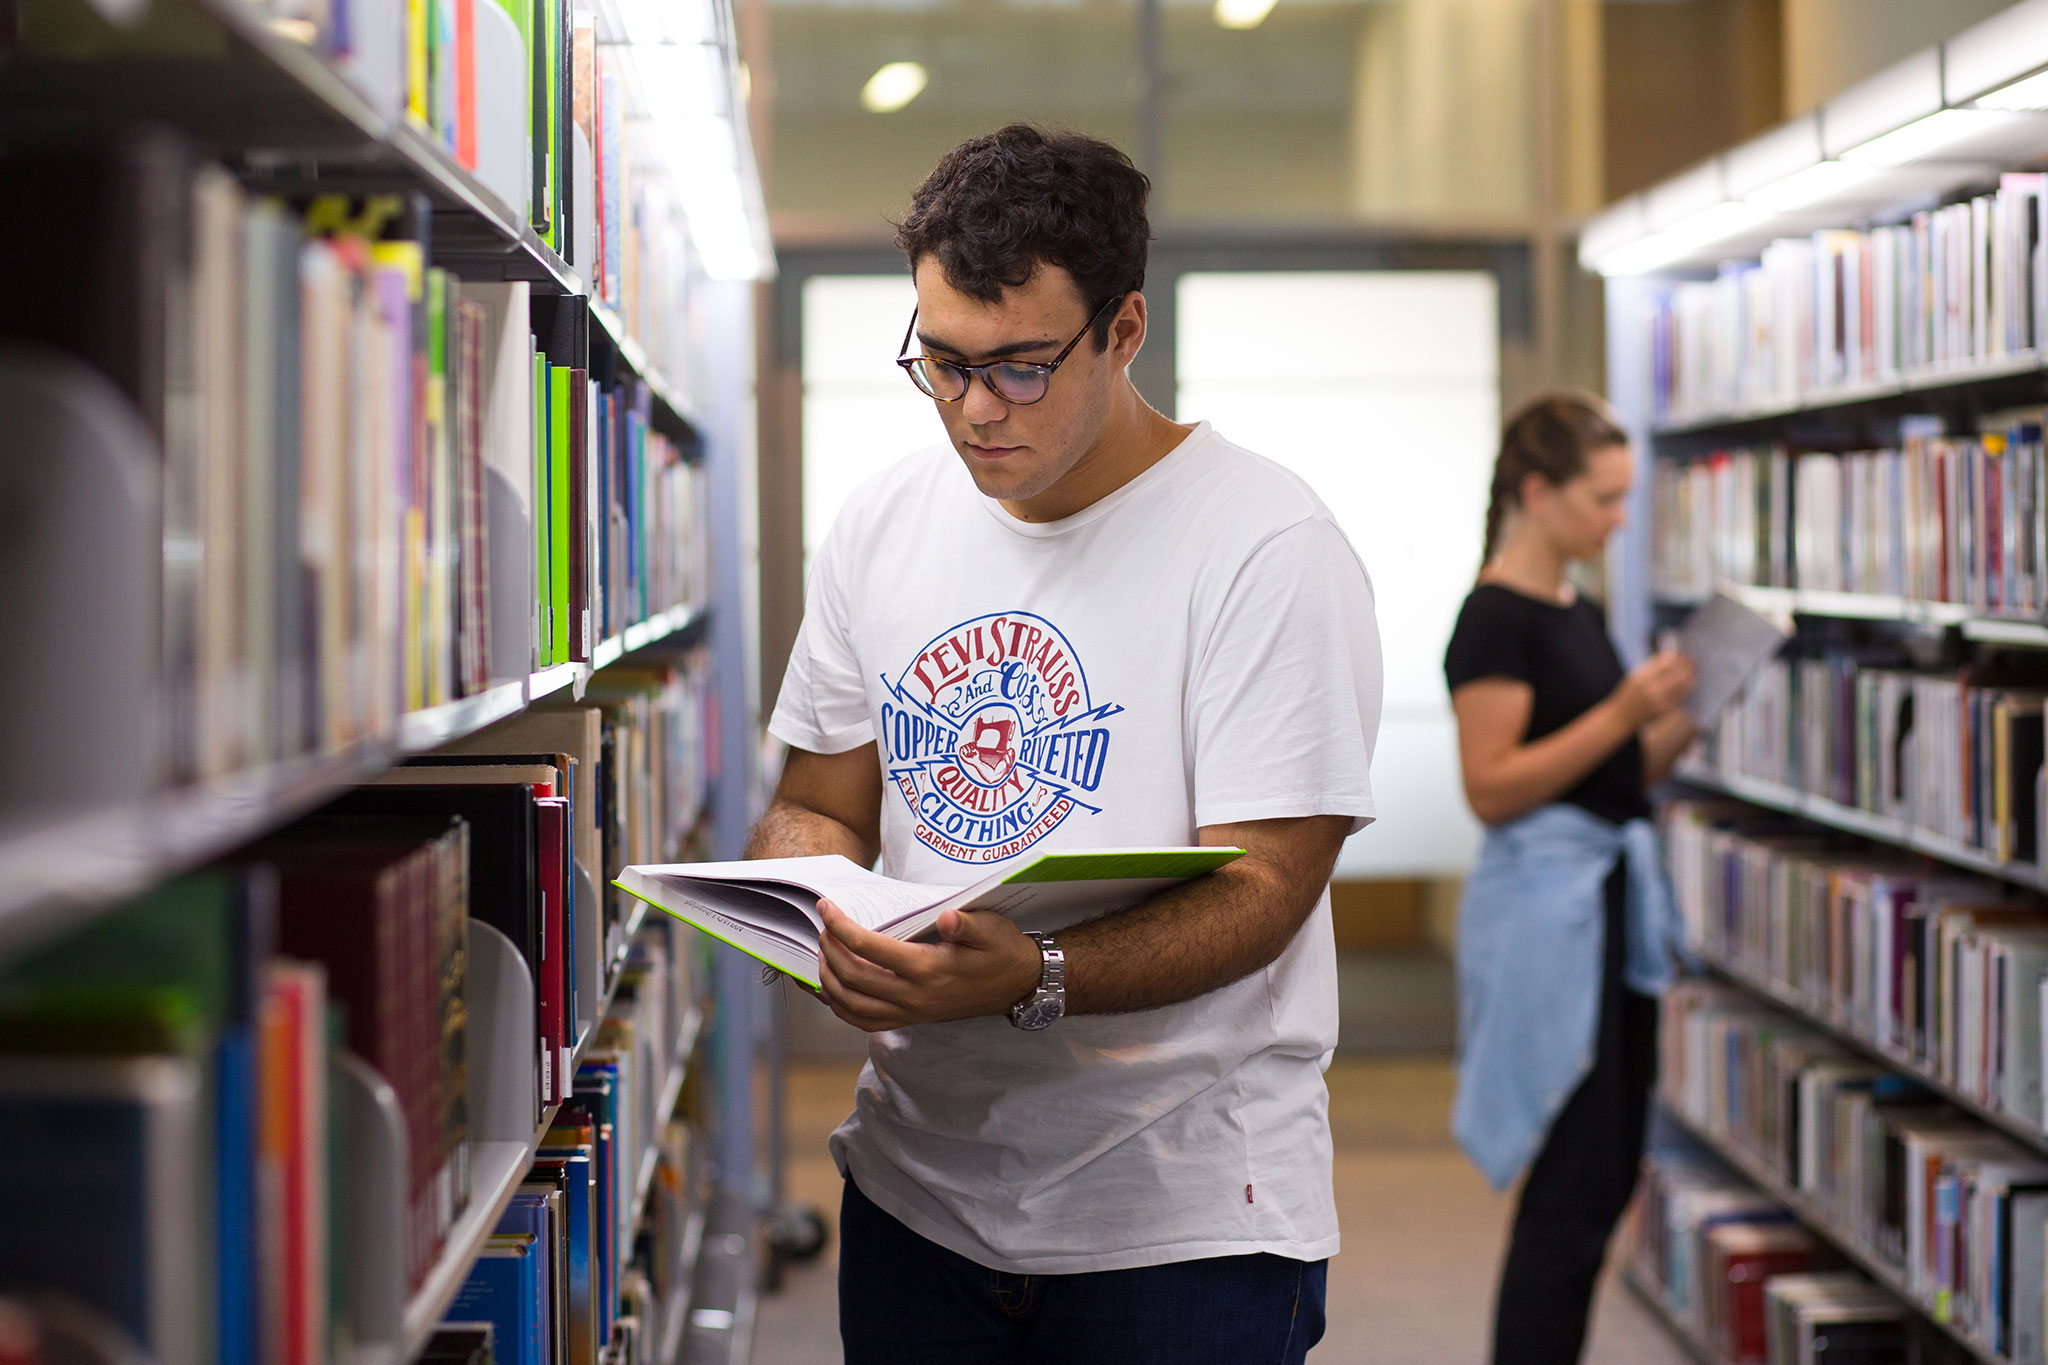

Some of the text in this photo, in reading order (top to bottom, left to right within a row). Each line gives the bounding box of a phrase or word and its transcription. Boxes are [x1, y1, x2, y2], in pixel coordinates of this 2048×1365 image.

[914, 616, 1080, 716] LEVI STRAUSS
[965, 674, 994, 704] And
[881, 702, 1110, 792] COPPER RIVETED
[900, 777, 1071, 861] EVE GARMENT GUARANTEED
[920, 792, 1034, 841] CLOTHING
[937, 766, 1025, 812] QUALITY
